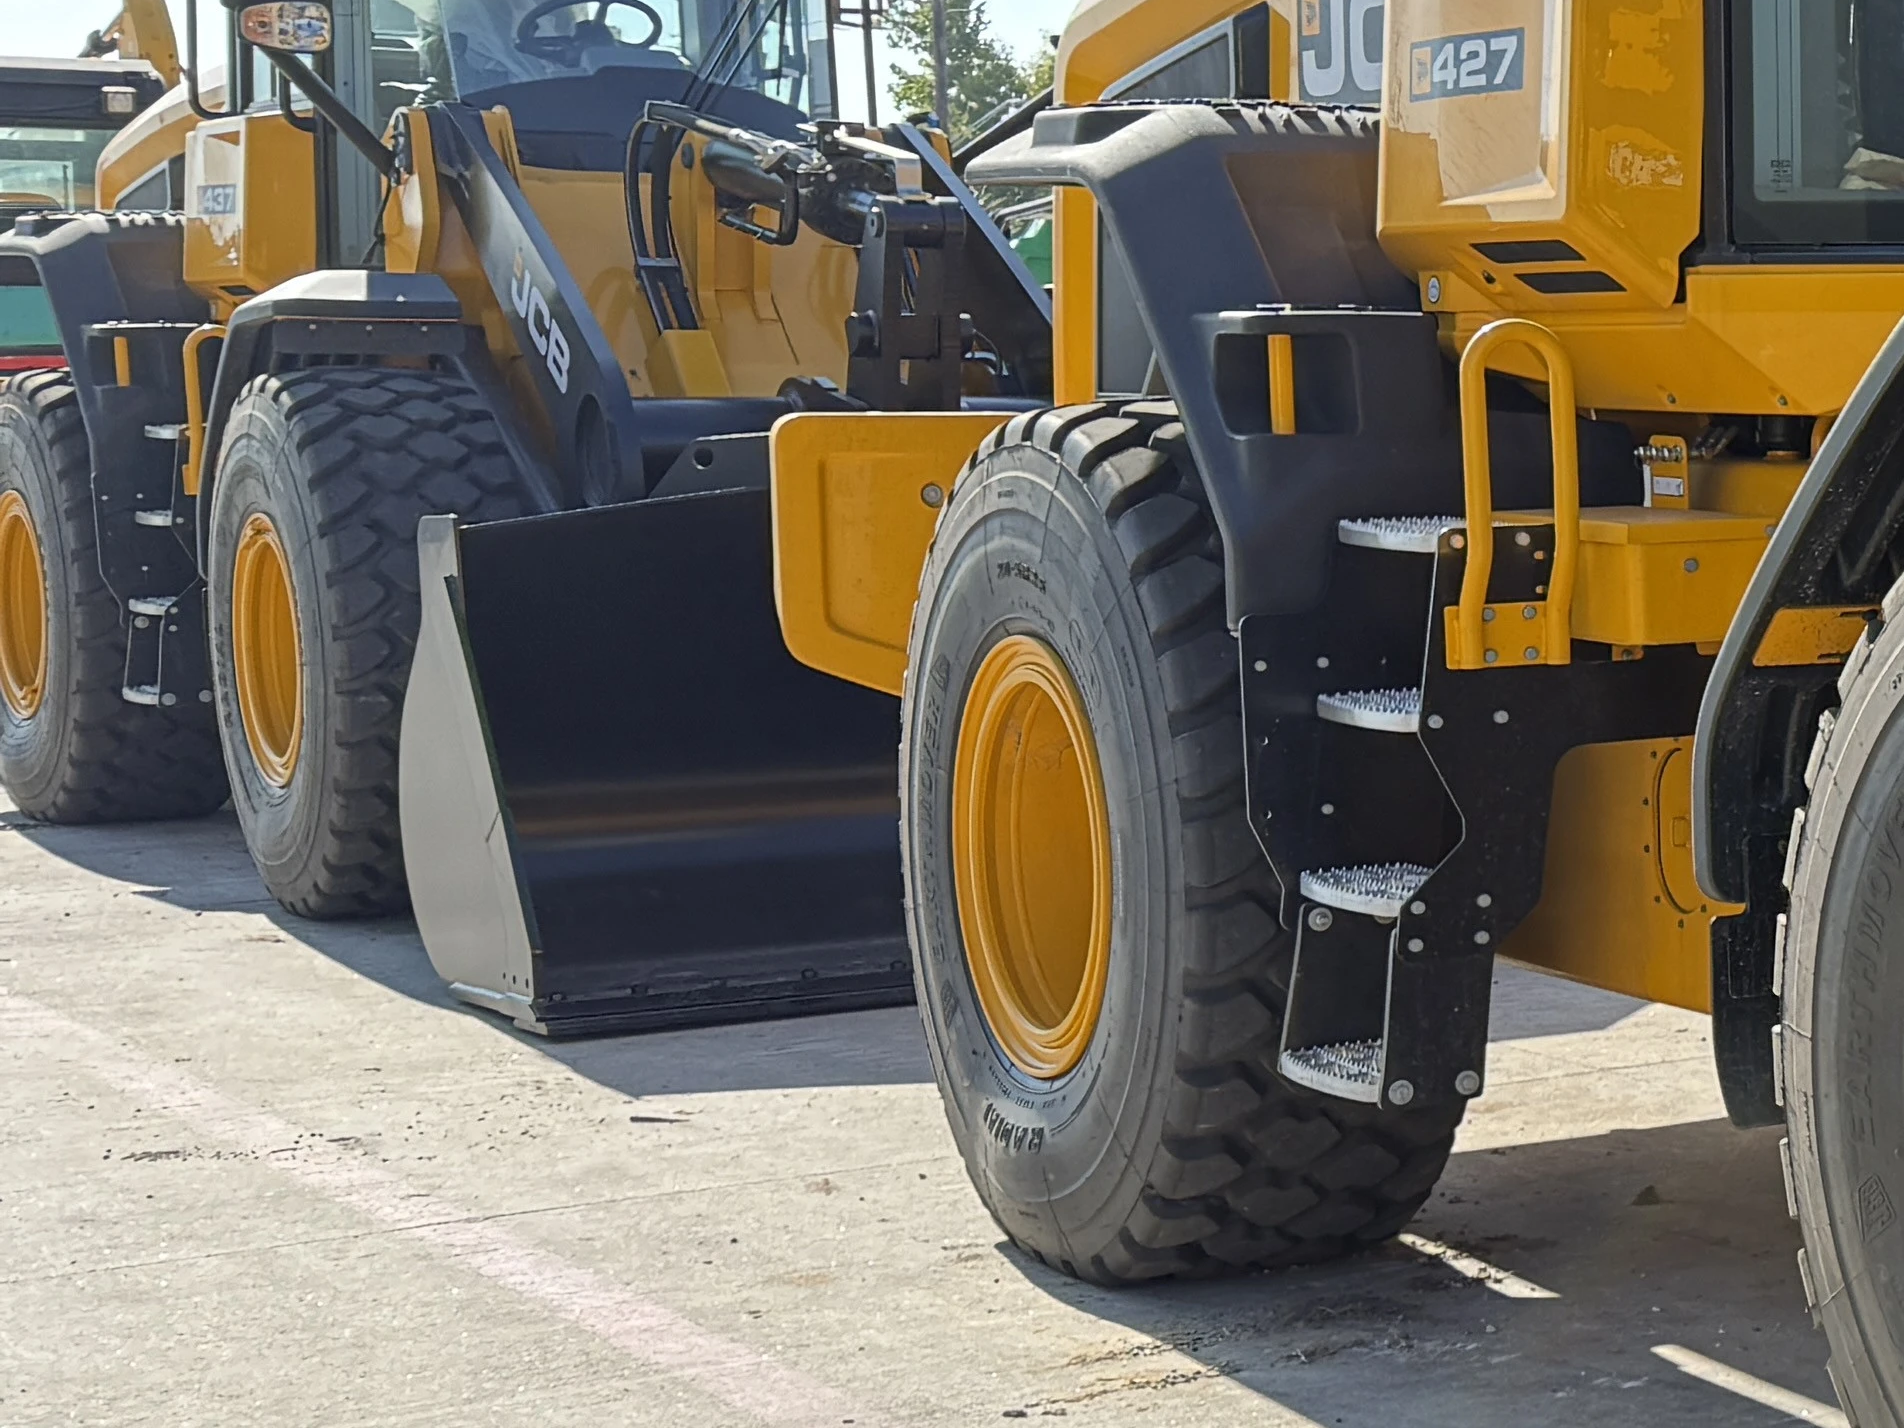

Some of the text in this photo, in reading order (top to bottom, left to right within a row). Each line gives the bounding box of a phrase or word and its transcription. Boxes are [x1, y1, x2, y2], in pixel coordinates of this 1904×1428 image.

[1431, 35, 1518, 90] 427
[203, 186, 235, 213] 437
[510, 269, 571, 395] JCB
